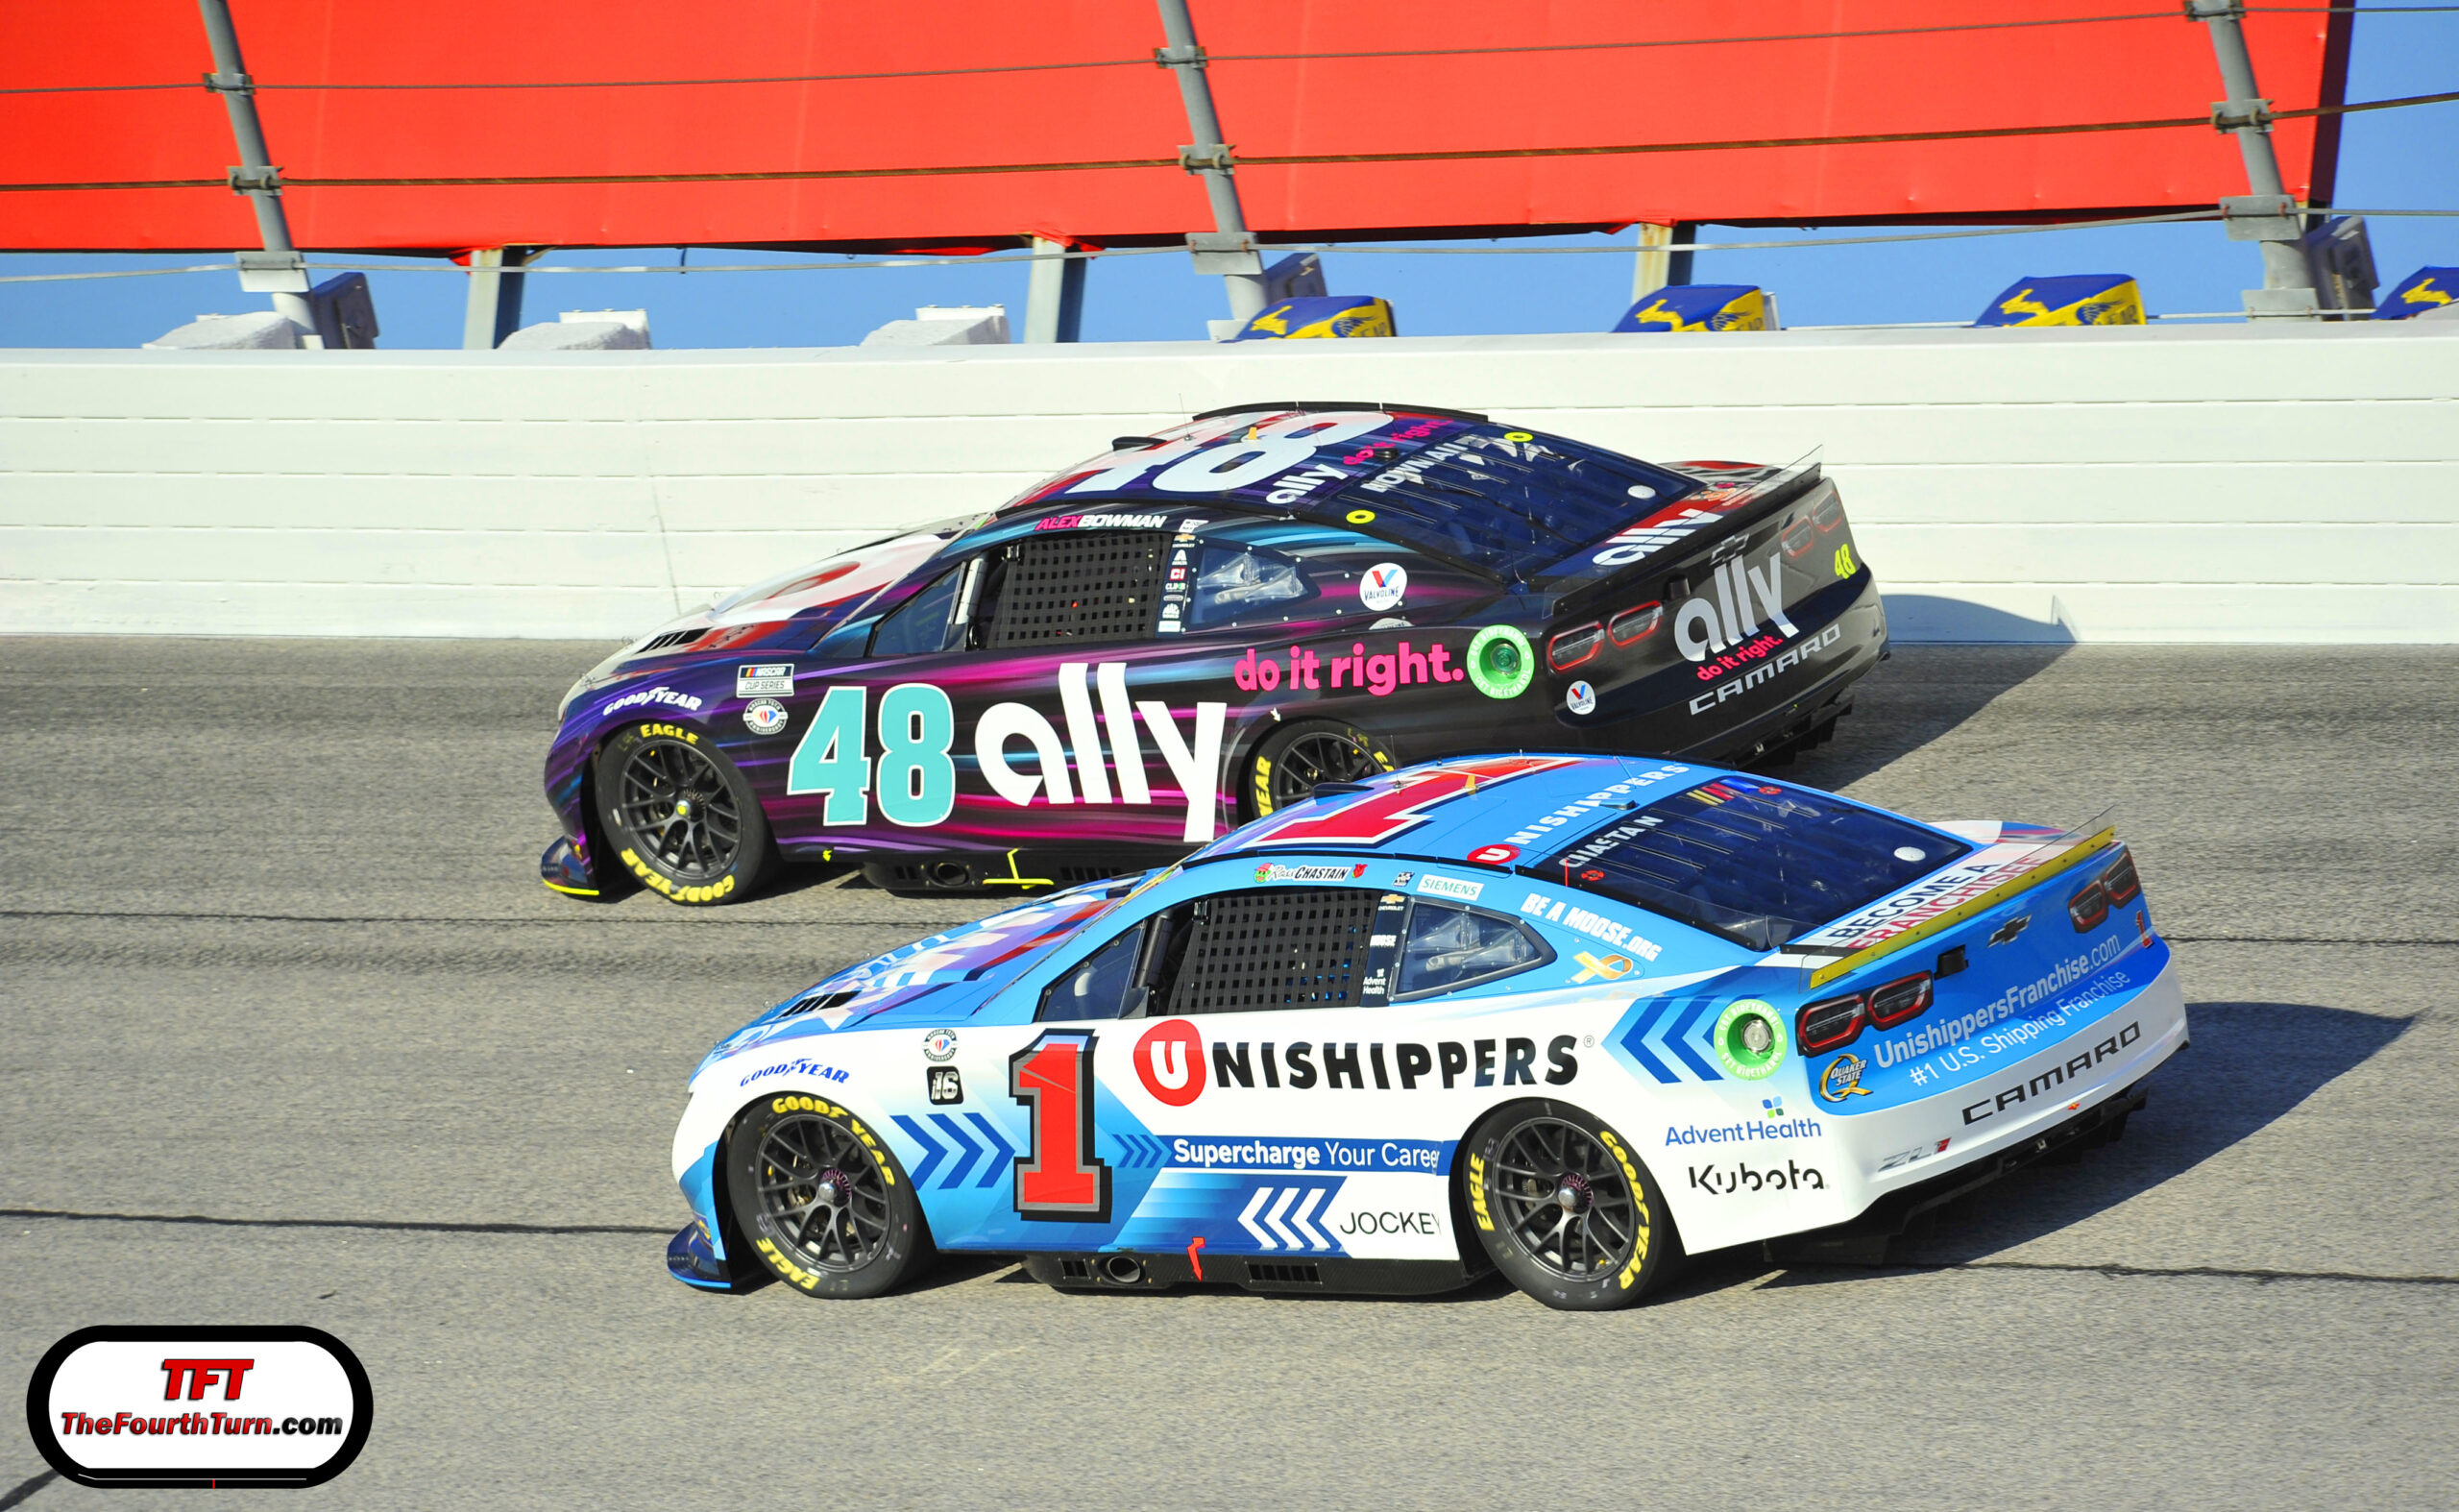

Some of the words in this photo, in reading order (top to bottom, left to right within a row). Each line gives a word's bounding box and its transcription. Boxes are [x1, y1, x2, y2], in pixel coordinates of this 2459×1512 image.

[1266, 464, 1348, 504] ally
[1592, 508, 1724, 566] ally
[1834, 544, 1857, 579] 48
[1364, 587, 1400, 600] VALVOLINE
[1674, 552, 1799, 662] ally
[761, 681, 785, 690] SERIES
[1233, 648, 1280, 692] do
[1289, 646, 1320, 691] it
[1330, 642, 1464, 696] right.
[1690, 623, 1841, 716] CAMARO
[1696, 663, 1723, 681] do
[1720, 654, 1740, 672] it
[1736, 637, 1784, 664] right.
[603, 686, 702, 716] GOODYEAR
[640, 723, 699, 745] EAGLE
[786, 684, 956, 827] 48
[974, 662, 1228, 842] ally
[1295, 866, 1350, 880] CHASTAIN
[1423, 878, 1477, 896] SIEMENS
[1829, 875, 1967, 939] BECOME
[1962, 863, 2002, 873] A
[1521, 893, 1550, 916] BE
[1546, 901, 1568, 922] A
[1563, 910, 1662, 963] MOOSE.ORG
[2134, 910, 2154, 949] 1
[1875, 935, 2121, 1068] UnishippersFranchise.com
[1909, 1061, 1938, 1086] #1
[1945, 1047, 1983, 1072] U.S.
[1984, 1008, 2066, 1055] Shipping
[2058, 970, 2130, 1018] Franchise
[740, 1058, 850, 1086] GOODYEAR
[1150, 1035, 1577, 1090] UNISHIPPERS
[1830, 1060, 1867, 1079] QUAKER
[1836, 1071, 1862, 1085] STATE
[1961, 1020, 2142, 1126] CAMARO
[1010, 1029, 1112, 1223] 1
[1173, 1139, 1321, 1169] Supercharge
[1325, 1141, 1376, 1166] Your
[1689, 1159, 1825, 1195] Kubota
[1470, 1153, 1495, 1232] EAGLE
[1599, 1131, 1651, 1289] GOODYEAR
[756, 1237, 820, 1290] EAGLE
